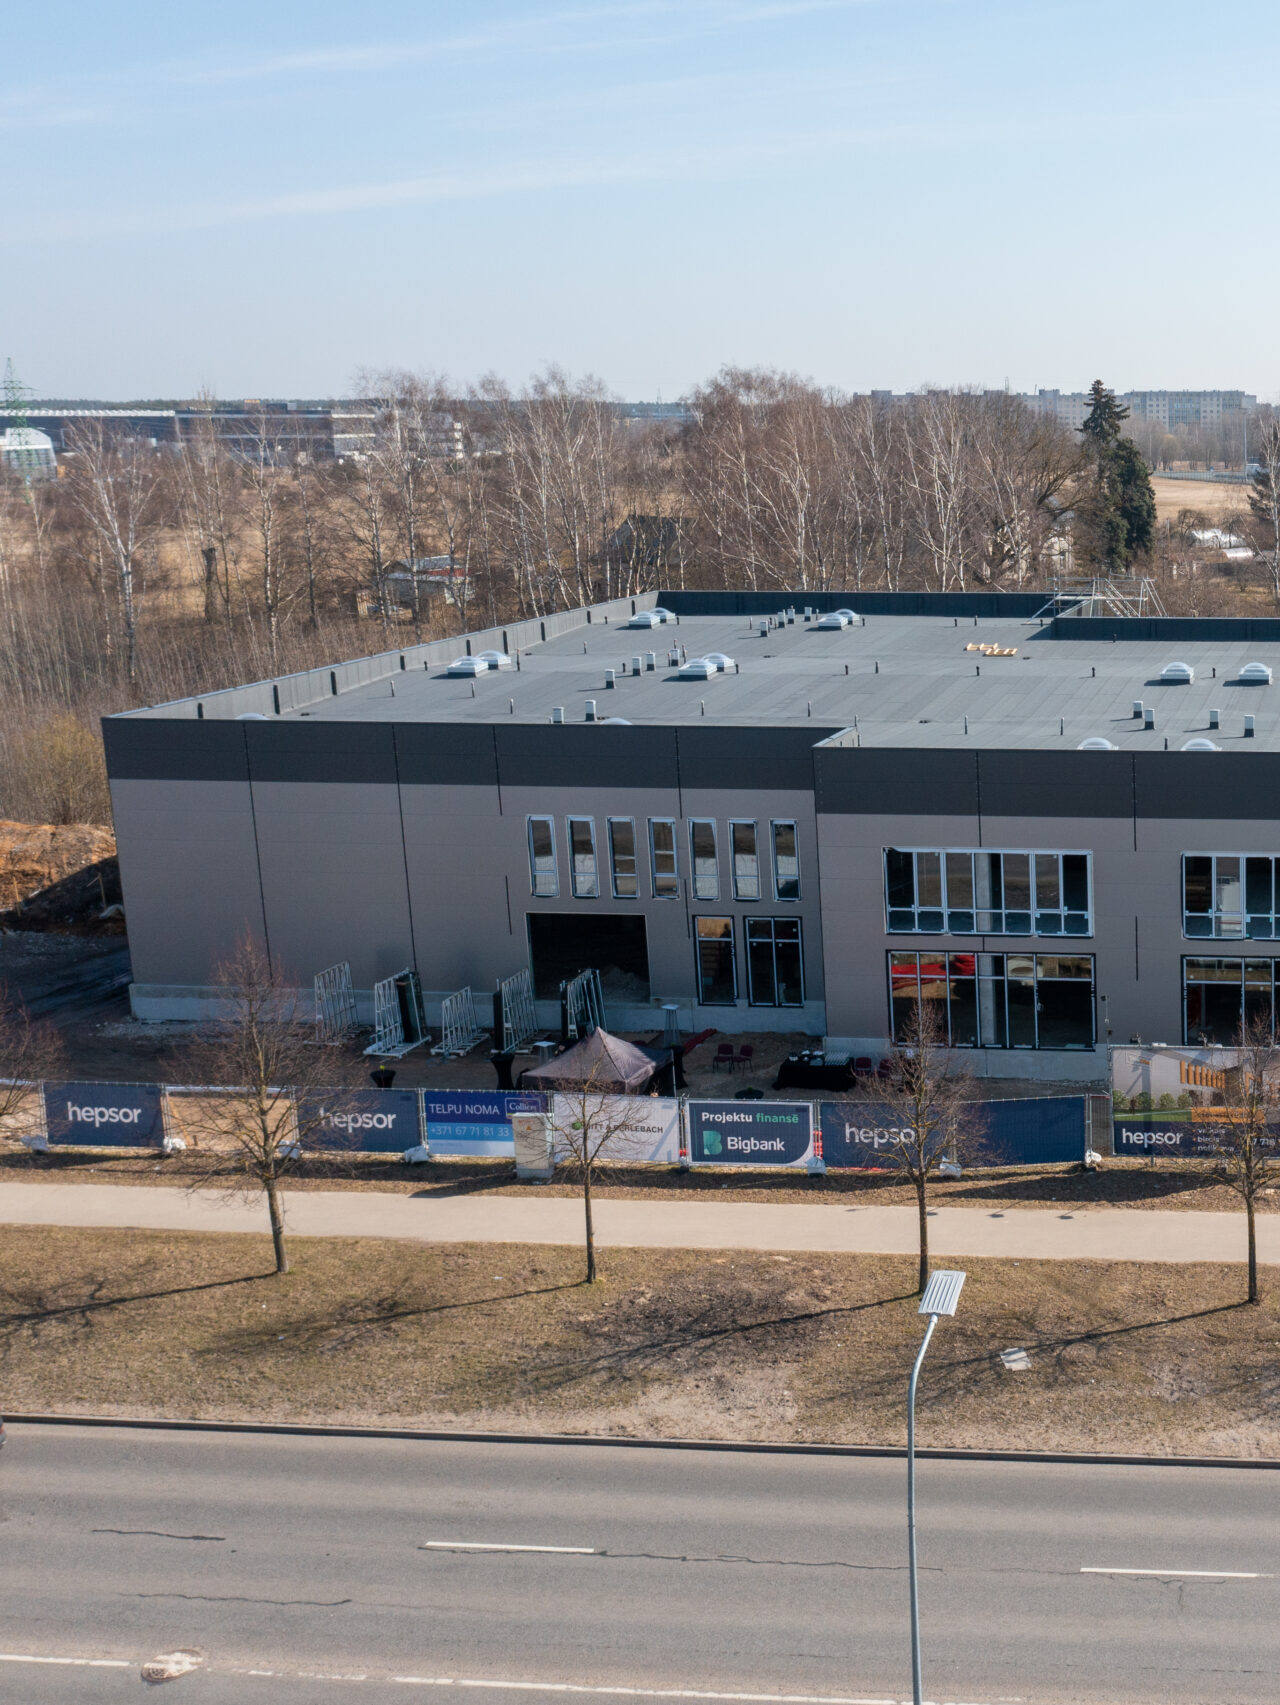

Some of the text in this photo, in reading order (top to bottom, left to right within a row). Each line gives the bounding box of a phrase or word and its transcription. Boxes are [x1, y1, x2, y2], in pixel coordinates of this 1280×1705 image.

[67, 1102, 141, 1127] hepsor
[429, 1104, 500, 1115] TELPU NOMA
[701, 1112, 799, 1124] Projektu finansē
[319, 1107, 397, 1133] hepsor
[431, 1126, 510, 1137] +371 67 71 81 33
[845, 1122, 924, 1148] hepso
[1122, 1128, 1184, 1148] hepsor
[727, 1136, 785, 1154] Bigbank
